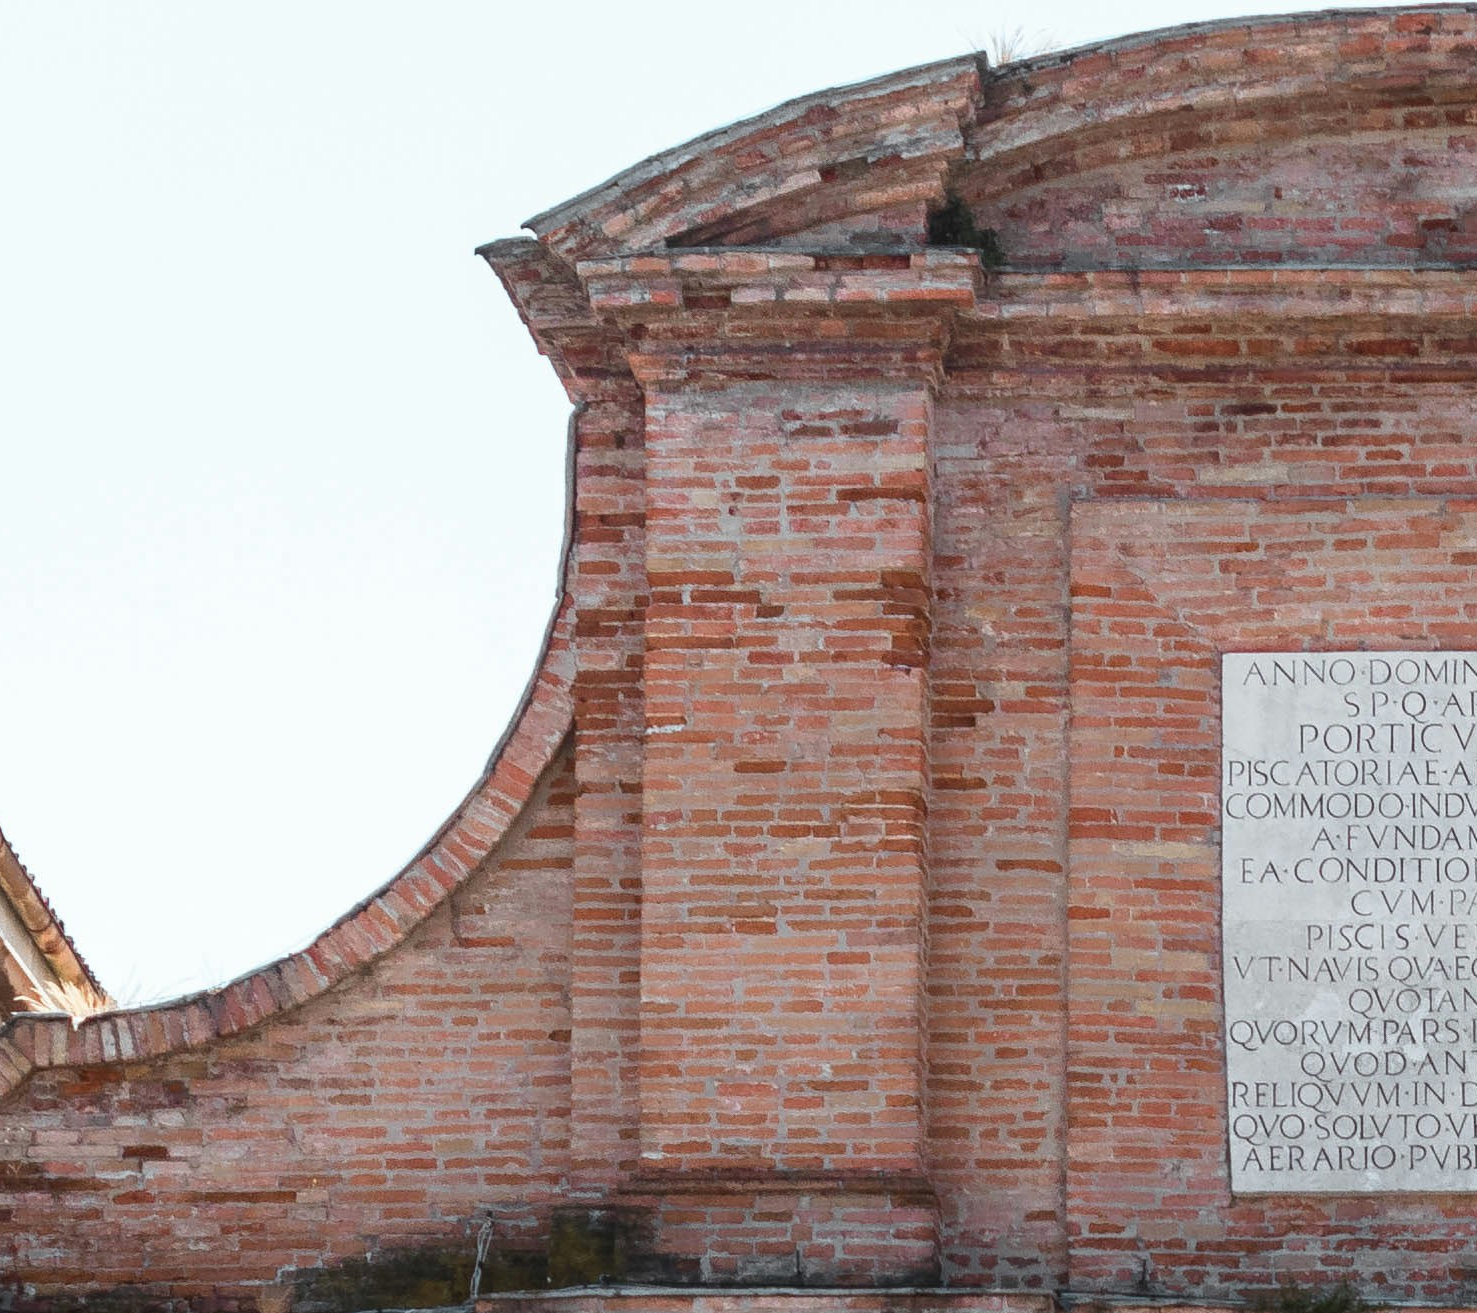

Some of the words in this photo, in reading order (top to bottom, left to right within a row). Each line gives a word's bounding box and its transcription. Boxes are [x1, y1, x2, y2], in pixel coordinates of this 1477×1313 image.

[1243, 659, 1356, 686] ANNO
[1227, 759, 1441, 787] PISCATORIAE
[1225, 792, 1404, 820] COMMODO
[1240, 857, 1283, 884] EA
[1350, 889, 1436, 917] CVM
[1306, 923, 1410, 951] PISCIS
[1233, 955, 1281, 983] VT
[1287, 955, 1380, 983] NAVIS
[1229, 1019, 1371, 1051] QVORVM
[1382, 1018, 1460, 1045] PARS
[1300, 1050, 1408, 1083] QVOD
[1231, 1081, 1401, 1114] RELIQVVM
[1413, 1081, 1446, 1106] IN
[1232, 1113, 1306, 1146] QVO
[1314, 1113, 1442, 1140] SOLVTO
[1242, 1144, 1397, 1171] AERARIO
